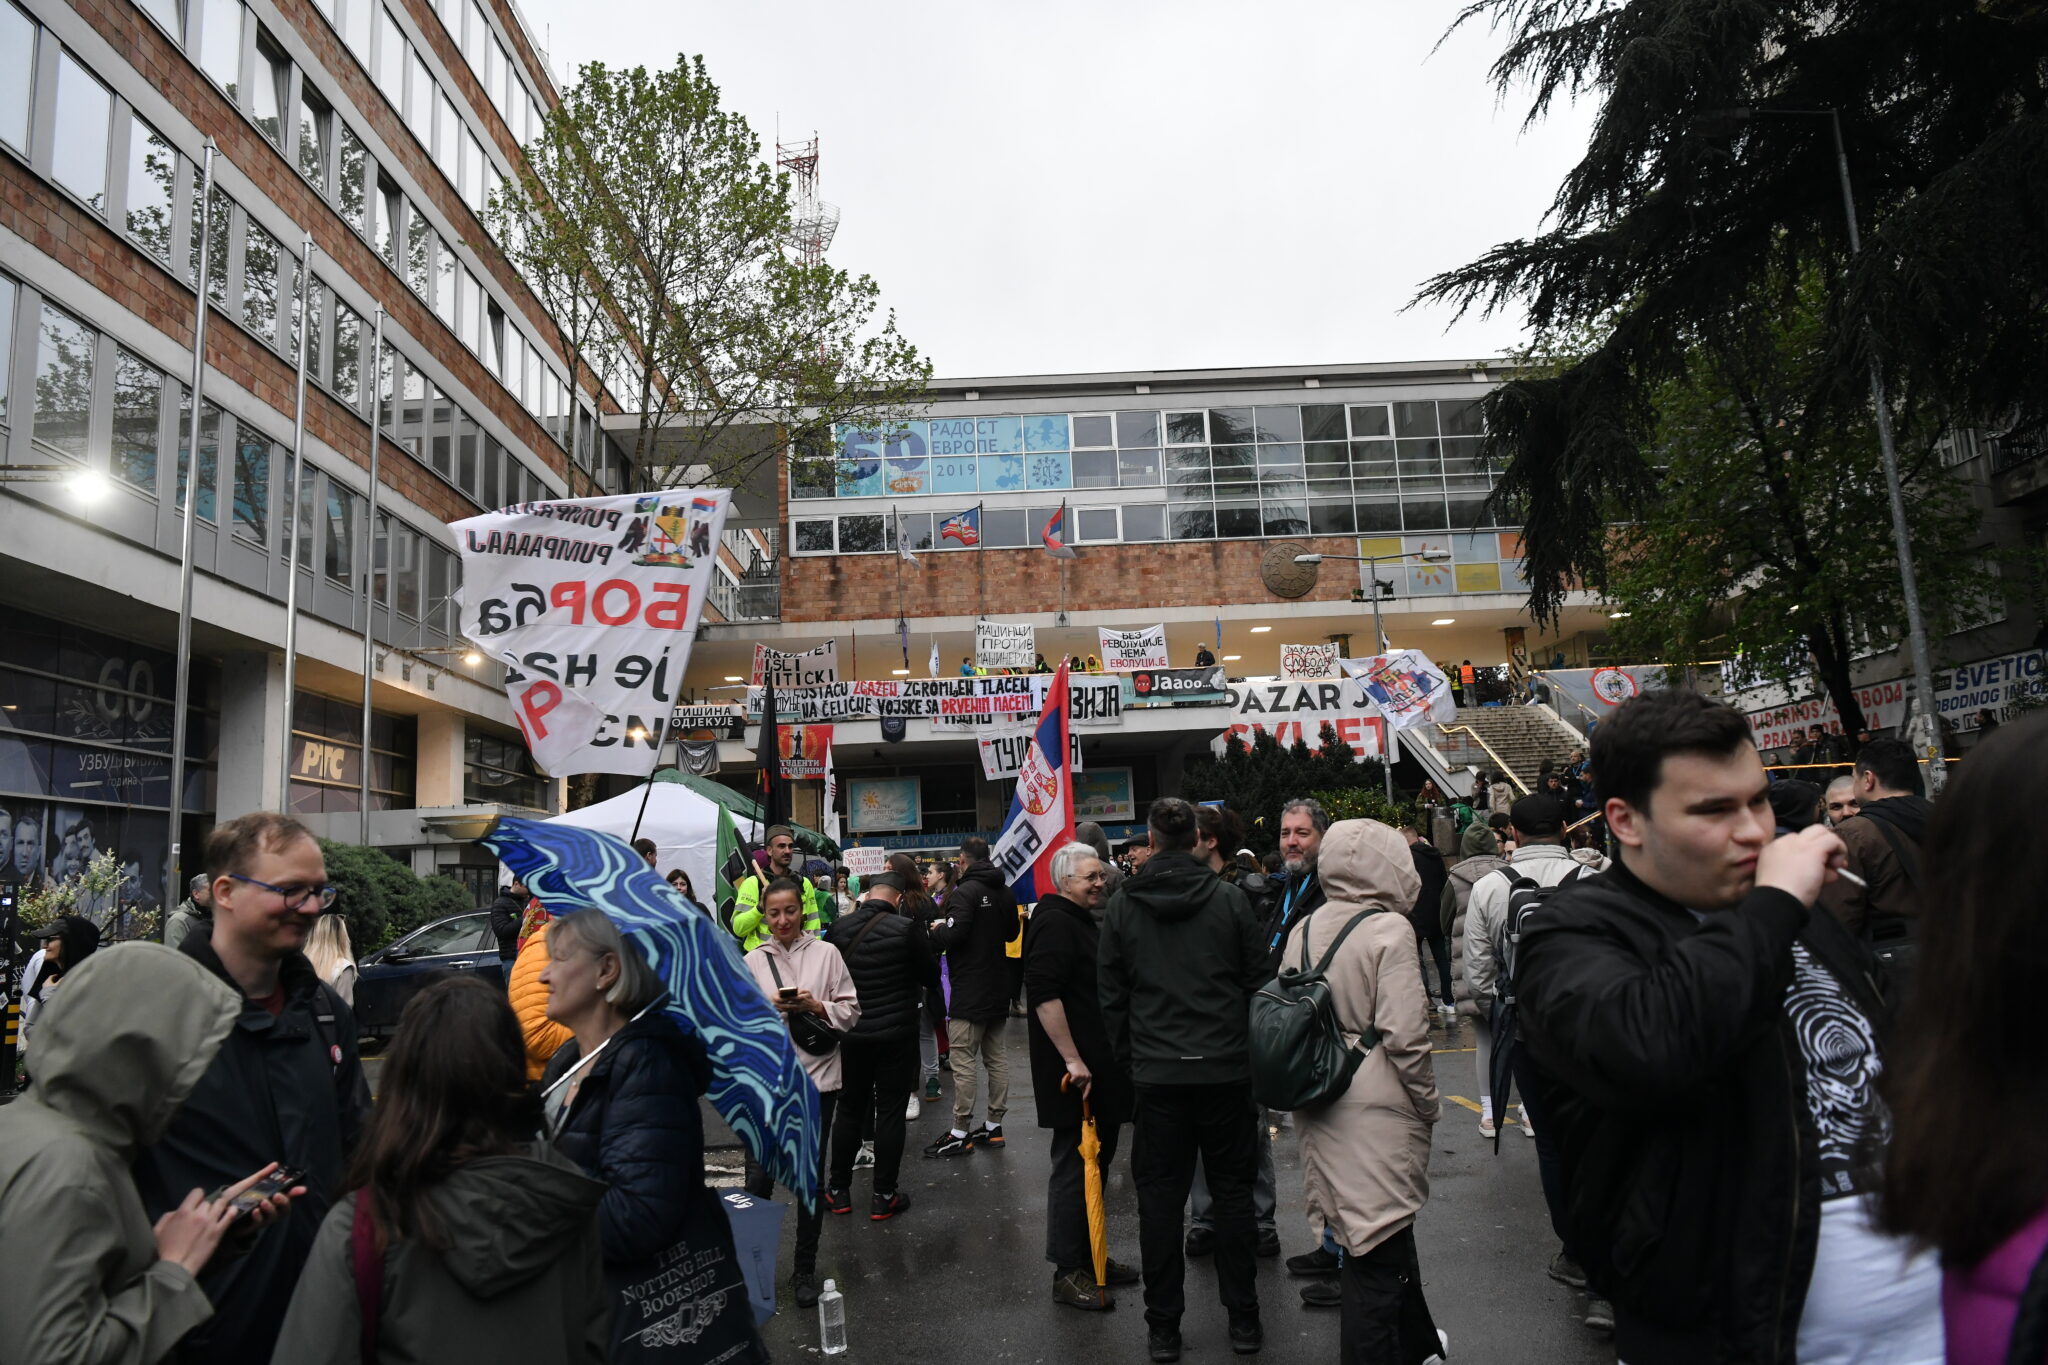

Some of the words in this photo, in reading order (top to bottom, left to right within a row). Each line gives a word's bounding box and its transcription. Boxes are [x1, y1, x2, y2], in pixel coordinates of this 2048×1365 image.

[929, 420, 998, 438] РАДОСТ
[932, 439, 998, 456] ЕВРОПЕ
[936, 463, 977, 478] 2019
[982, 638, 1034, 650] ПРОТИВ
[1102, 637, 1164, 648] РЕВОЛУЦИЈЕ
[1110, 657, 1167, 667] ЕВОЛУЦИЈЕ
[1121, 649, 1147, 658] НЕМА
[755, 659, 800, 671] MISLI
[1956, 652, 2048, 691] SVETIO
[97, 656, 155, 723] 60
[802, 702, 817, 719] NA
[822, 696, 872, 717] ČELIČNE
[877, 697, 923, 716] VOJSKE
[925, 698, 939, 715] SA
[942, 695, 990, 714] DRVENIM
[993, 693, 1034, 713] MAČEM!
[1226, 685, 1341, 714] PAZAR
[675, 706, 731, 717] ТИШИНА
[671, 717, 734, 729] ОДЈЕКУЈЕ
[653, 1240, 689, 1269] THE
[621, 1260, 695, 1306] NOTTING
[694, 1246, 727, 1270] HILL
[640, 1268, 717, 1319] BOOKSHOP
